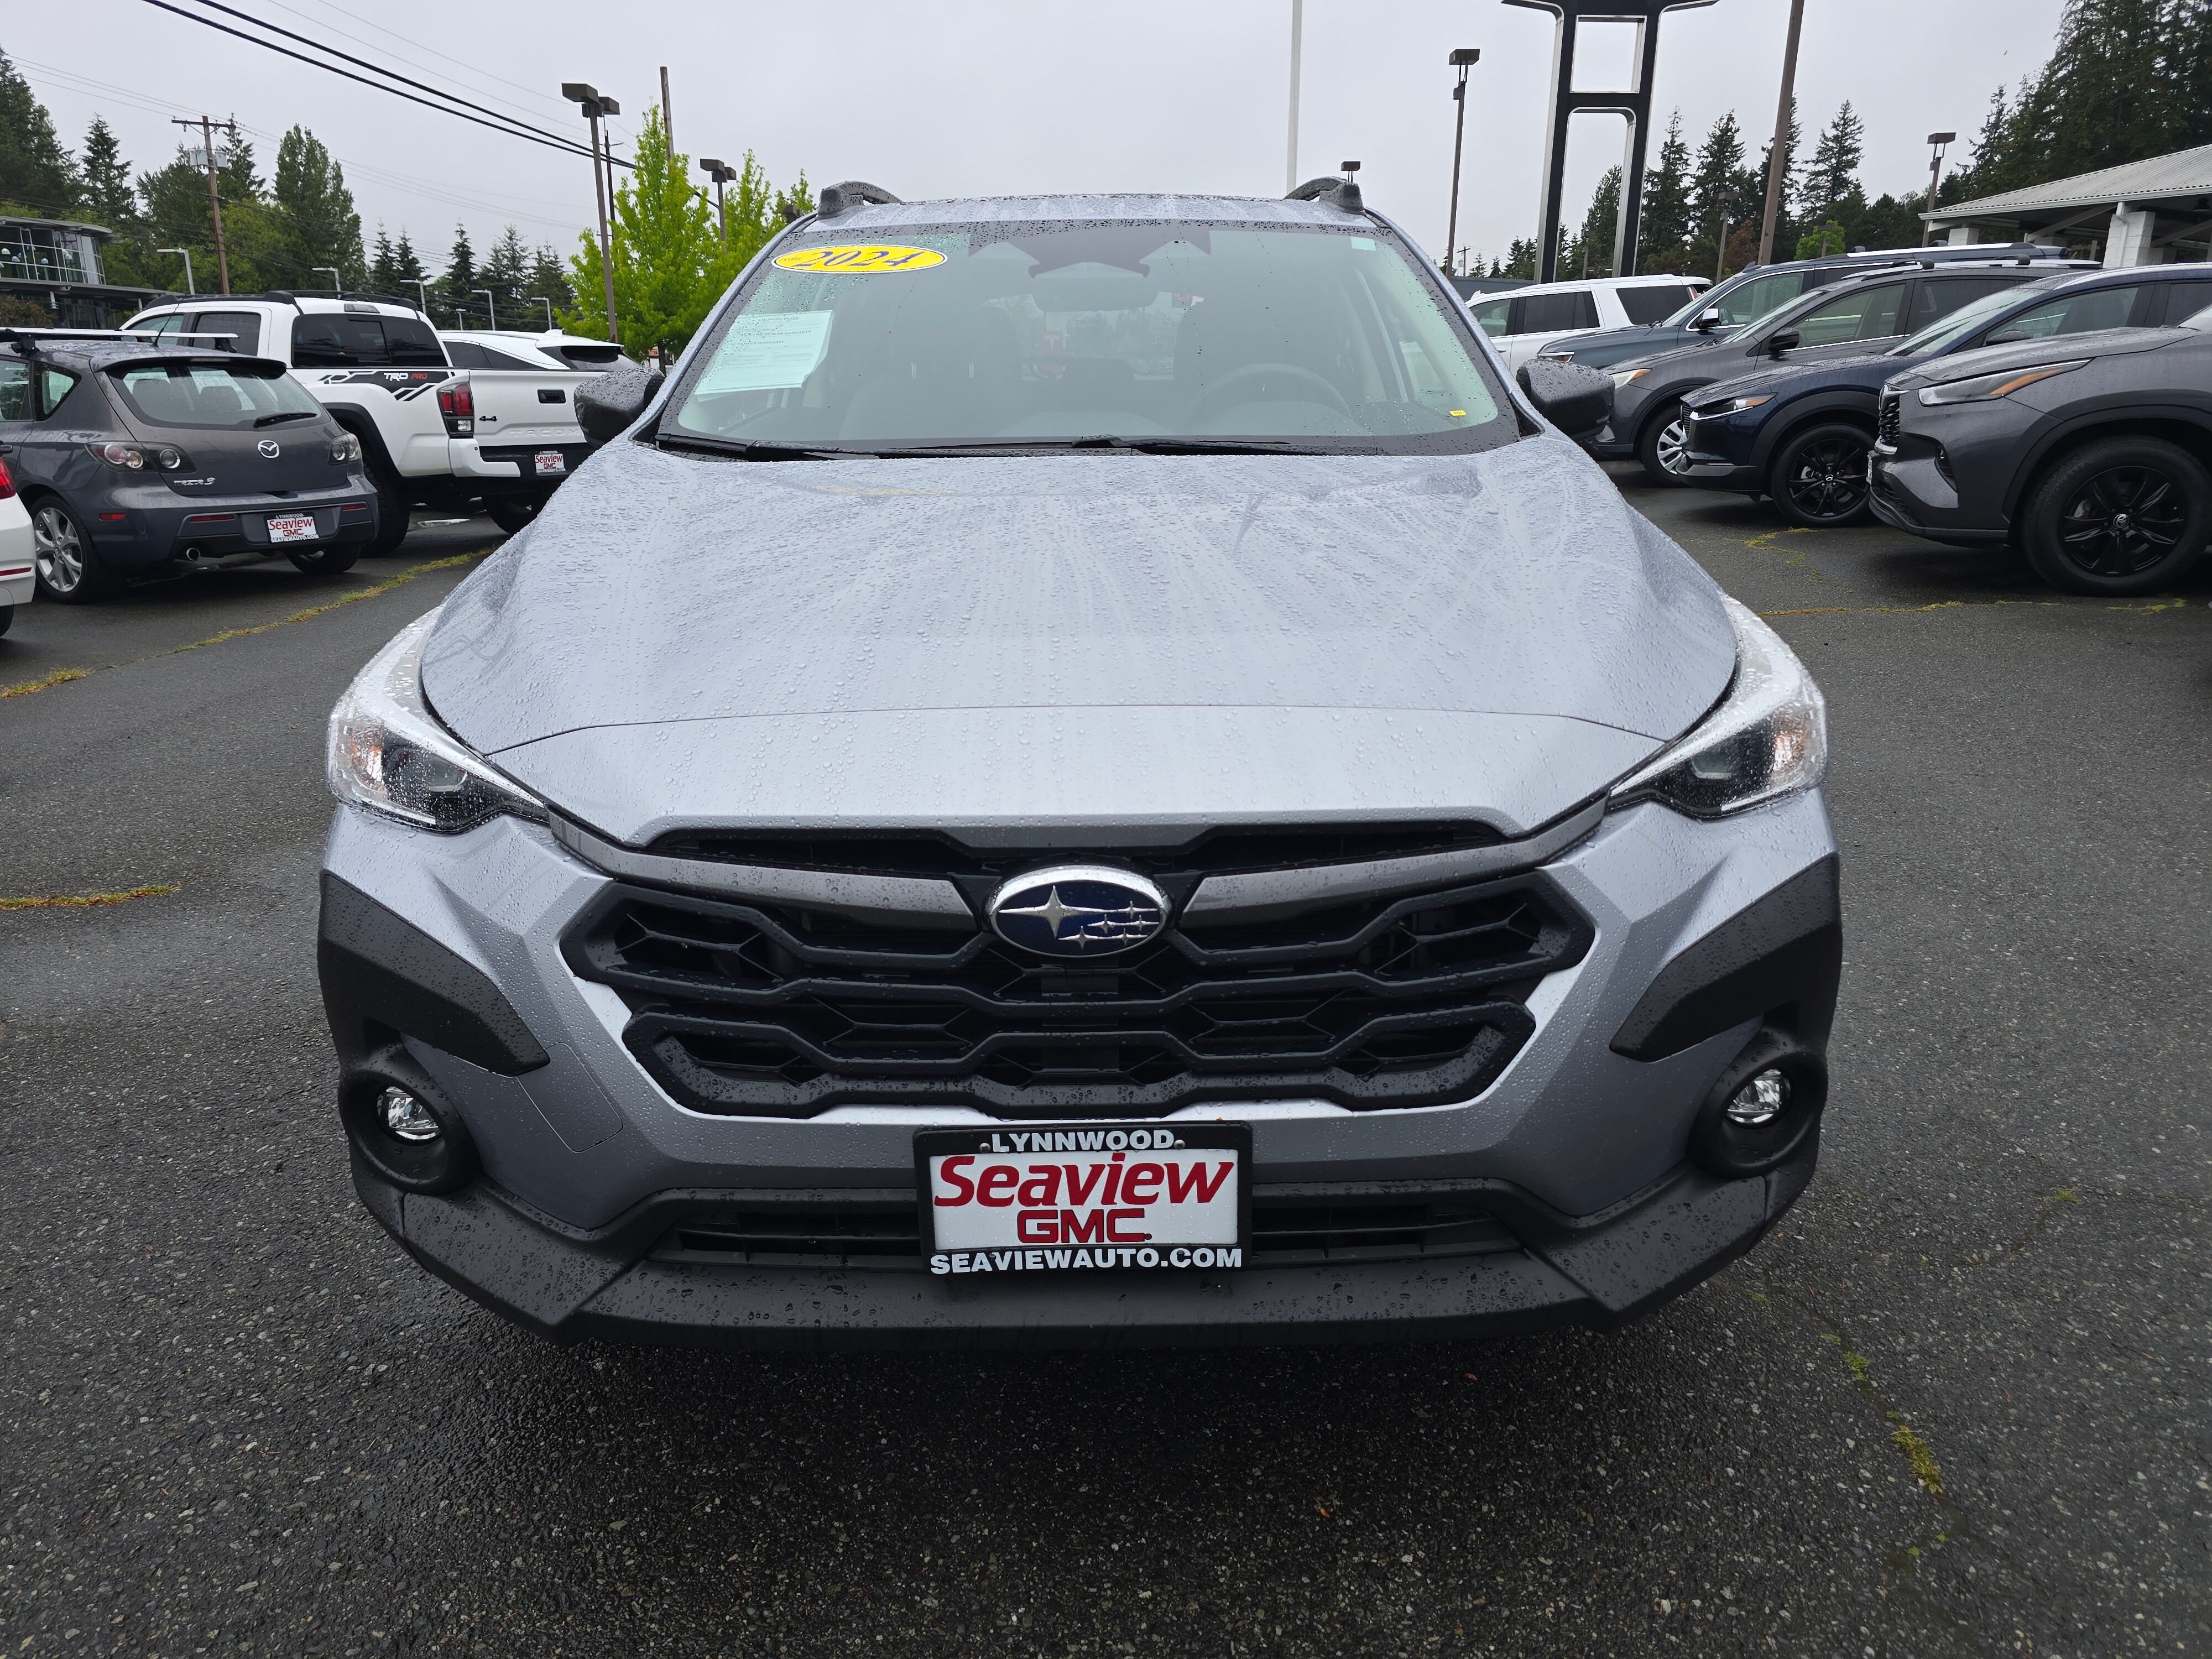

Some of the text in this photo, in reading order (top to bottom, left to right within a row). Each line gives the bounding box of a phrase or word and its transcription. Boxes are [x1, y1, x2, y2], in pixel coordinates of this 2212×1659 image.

[791, 250, 925, 267] 2024
[383, 372, 409, 382] TRD
[509, 428, 581, 437] TACOM
[535, 455, 563, 463] Seaview
[269, 518, 312, 530] Seaview
[283, 528, 304, 537] GMC
[992, 1130, 1174, 1152] LYNNWOOD
[933, 1152, 1234, 1207] Seaview
[1016, 1208, 1146, 1244] GMC
[930, 1248, 1242, 1275] SEAVIEWAUTO.COM
